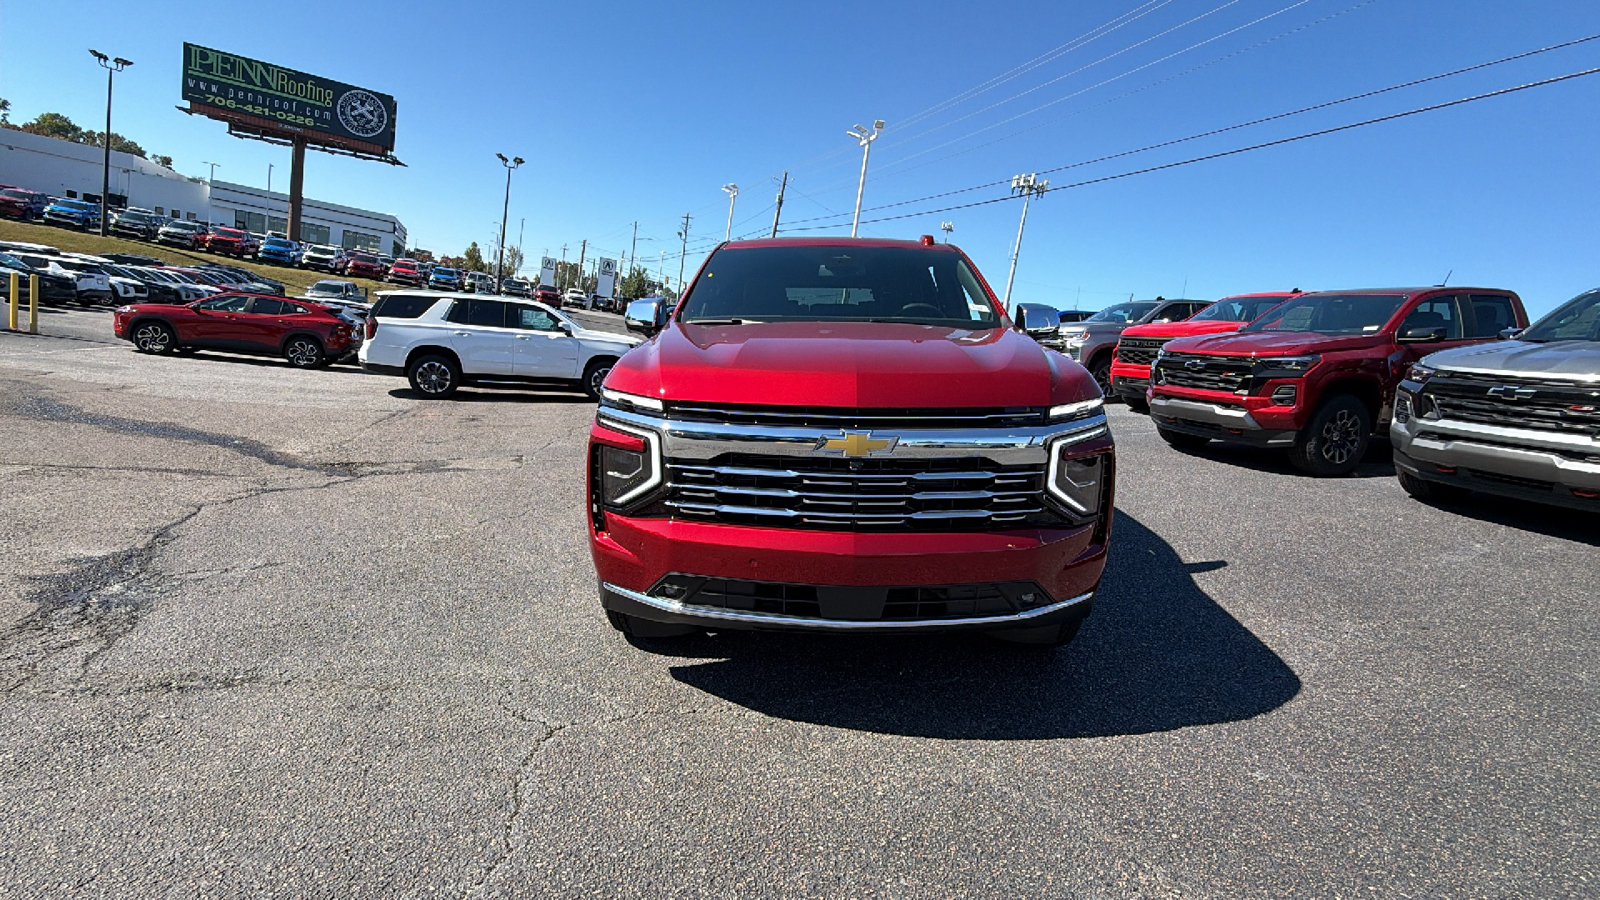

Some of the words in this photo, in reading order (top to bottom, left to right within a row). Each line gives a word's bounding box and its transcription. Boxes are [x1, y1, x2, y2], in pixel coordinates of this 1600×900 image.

[188, 45, 294, 90] PENN
[278, 72, 333, 107] Roofing
[188, 78, 331, 120] www.pennroof.com
[205, 94, 314, 126] 706-421-0226
